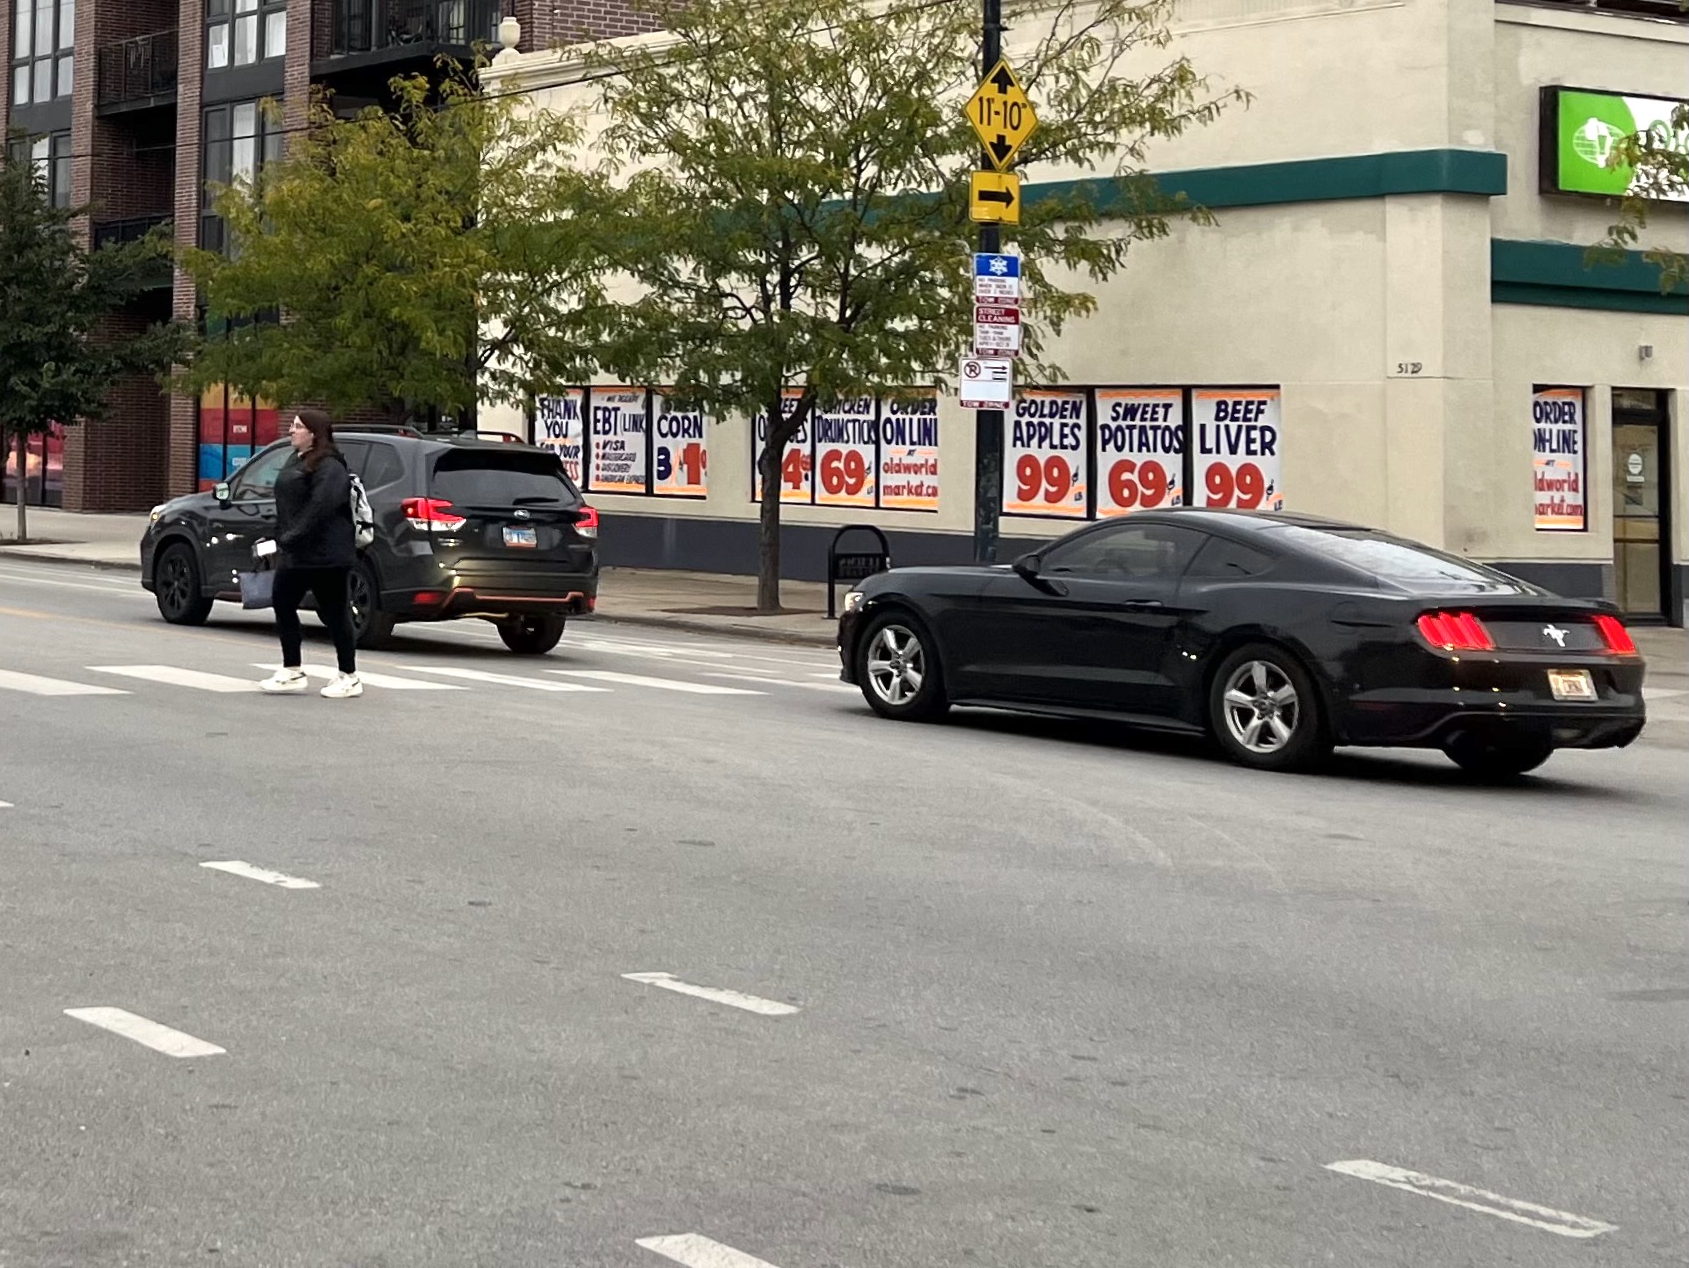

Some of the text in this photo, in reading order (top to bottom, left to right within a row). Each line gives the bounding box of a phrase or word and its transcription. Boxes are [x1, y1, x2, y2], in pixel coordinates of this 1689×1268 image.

[539, 397, 580, 420] THANK
[1015, 399, 1083, 420] GOLDEN
[1110, 402, 1173, 423] SWEET
[1214, 400, 1268, 423] BEEF
[1533, 400, 1577, 425] ORDER
[545, 420, 569, 438] YOU
[593, 405, 621, 436] EBT
[657, 414, 703, 439] CORN
[602, 439, 626, 451] VISA
[1012, 421, 1081, 451] APPLES
[1099, 424, 1185, 454] POTATOS
[1199, 423, 1277, 456] LIVER
[882, 459, 938, 475] oldworld
[1534, 471, 1579, 493] ldworld
